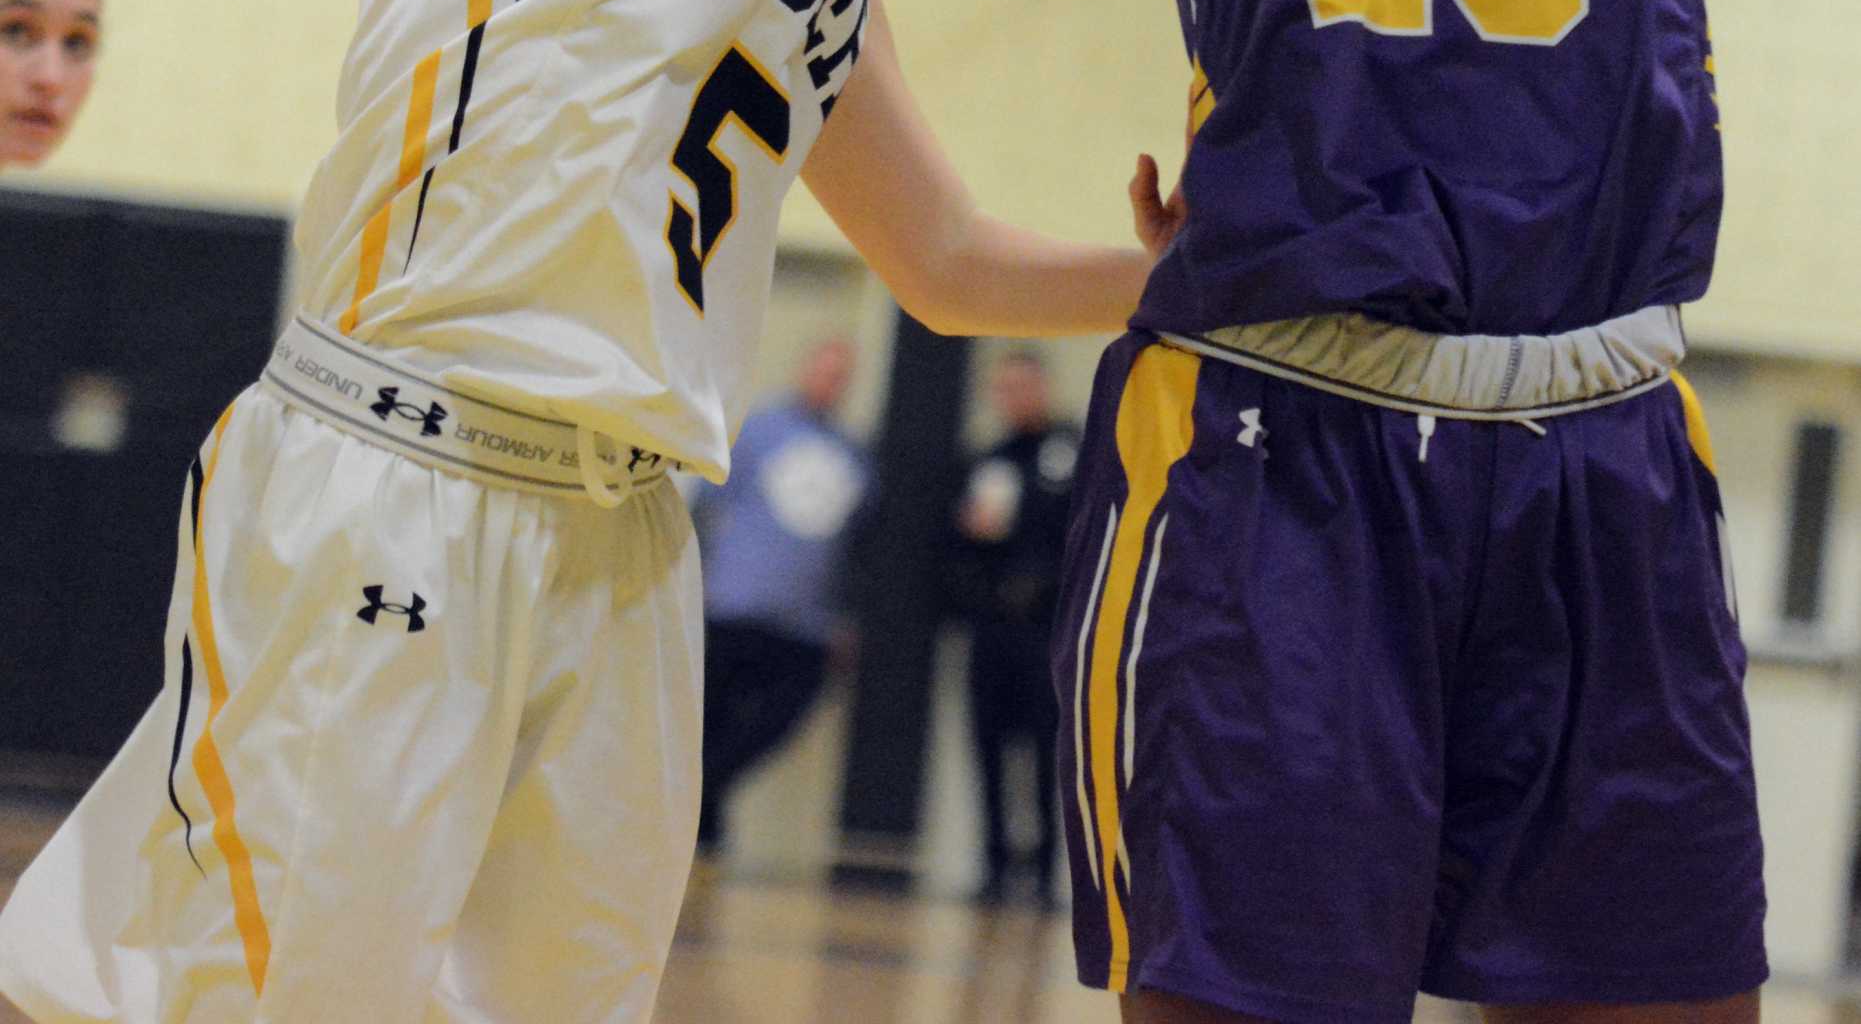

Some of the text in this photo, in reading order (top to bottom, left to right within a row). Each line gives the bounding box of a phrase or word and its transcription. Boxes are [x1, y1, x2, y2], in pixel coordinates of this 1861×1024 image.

[663, 40, 791, 319] 5
[294, 353, 363, 400] UNDER
[454, 423, 553, 462] ARMOUR
